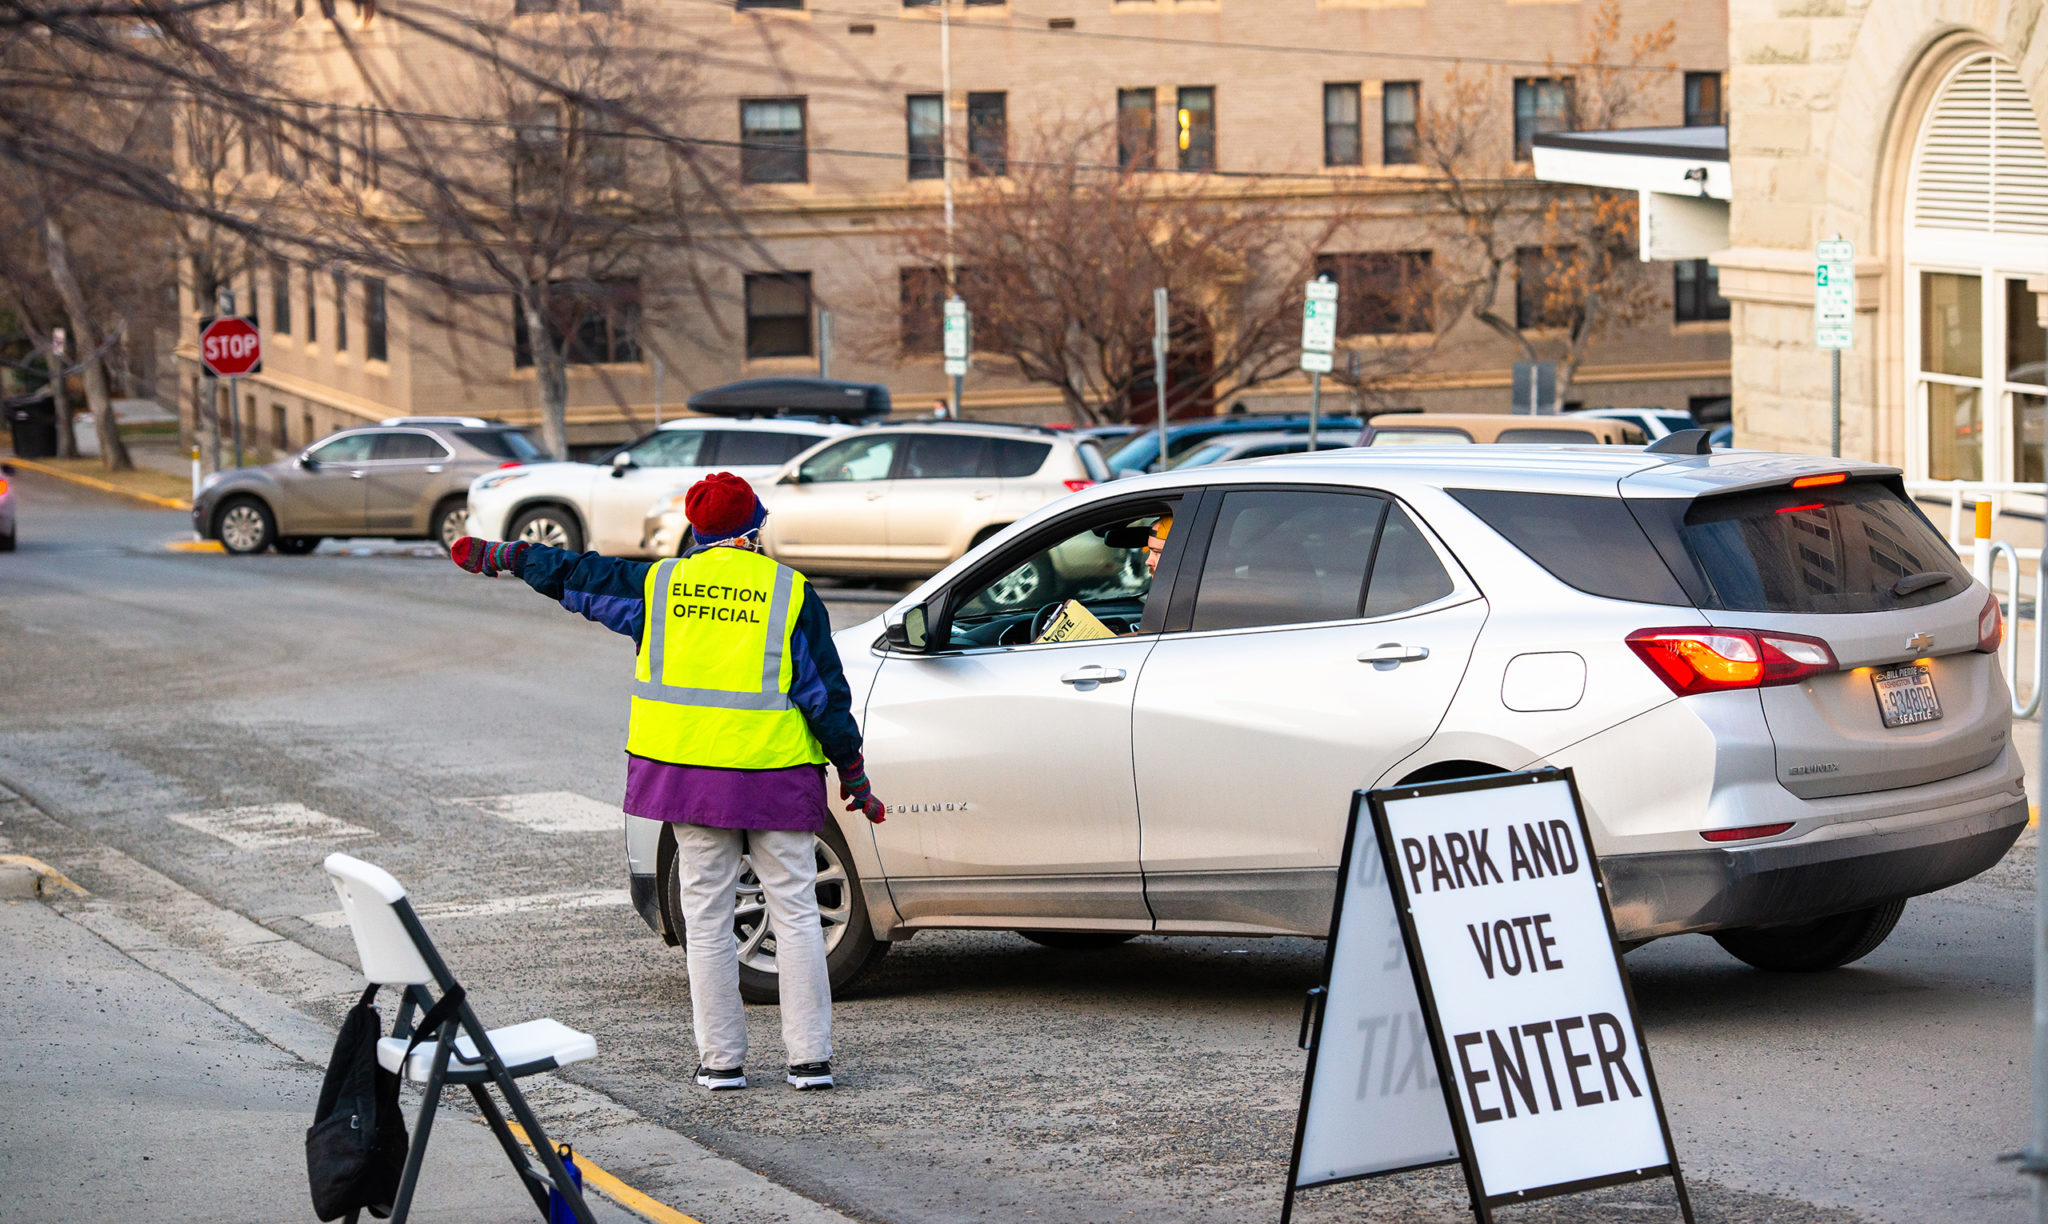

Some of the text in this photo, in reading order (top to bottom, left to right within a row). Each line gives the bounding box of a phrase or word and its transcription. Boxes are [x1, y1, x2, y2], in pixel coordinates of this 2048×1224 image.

[205, 333, 257, 360] STOP
[672, 583, 767, 603] ELECTION
[673, 604, 760, 623] OFFICIAL
[1051, 619, 1075, 643] VOTE
[1886, 669, 1899, 680] BILL
[1899, 711, 1932, 724] SEATTLE
[1789, 763, 1840, 776] EQUINOX
[886, 801, 968, 814] EQUINOX
[1401, 828, 1504, 894] PARK
[1507, 818, 1580, 882] AND
[1467, 913, 1564, 980] VOTE
[1453, 1011, 1643, 1125] ENTER
